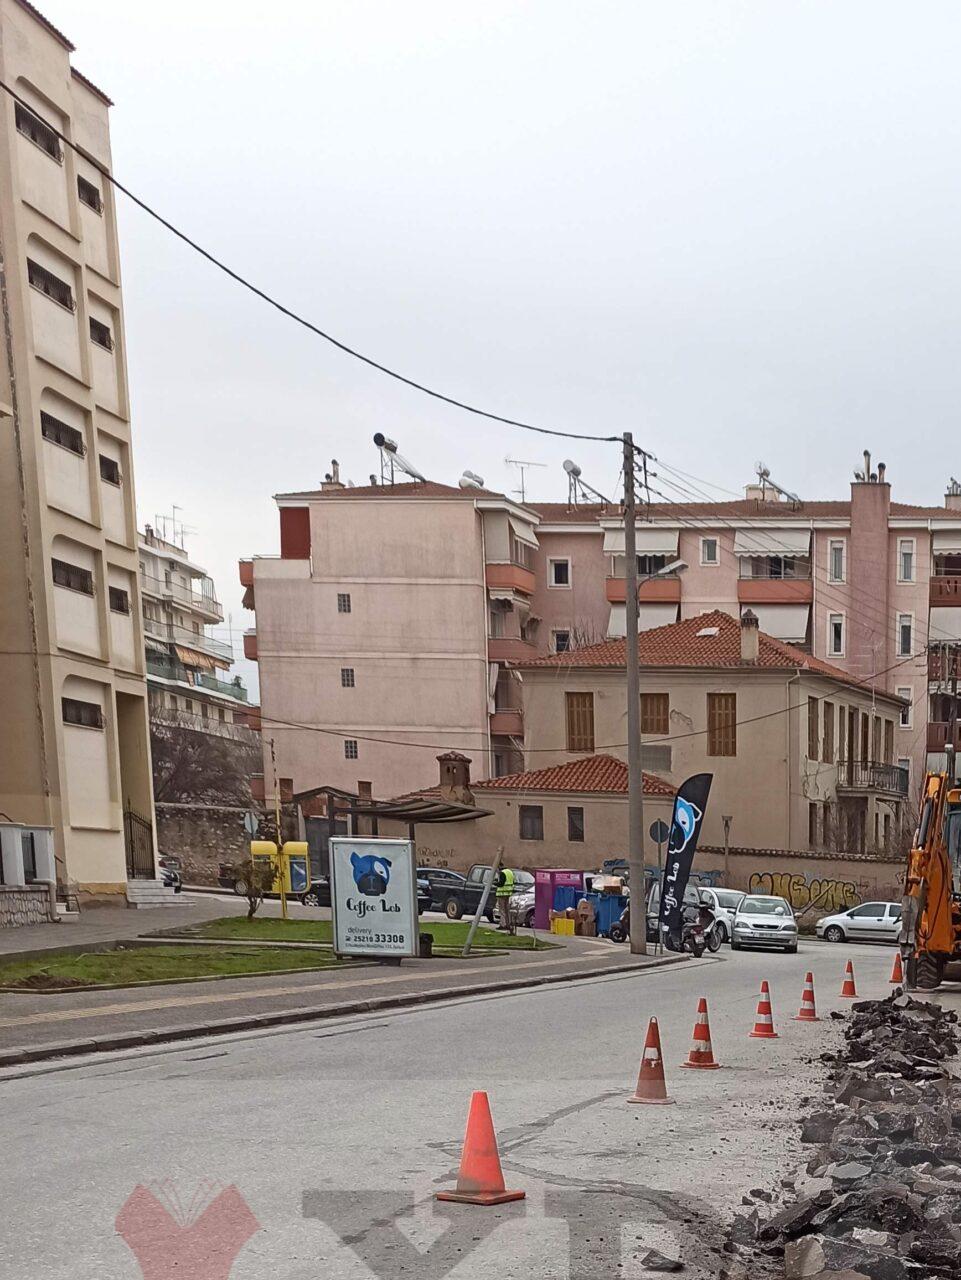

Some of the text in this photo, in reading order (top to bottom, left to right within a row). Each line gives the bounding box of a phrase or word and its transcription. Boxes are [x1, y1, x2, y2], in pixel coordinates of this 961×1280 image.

[347, 926, 372, 935] delivery
[353, 934, 405, 943] 25210 33308
